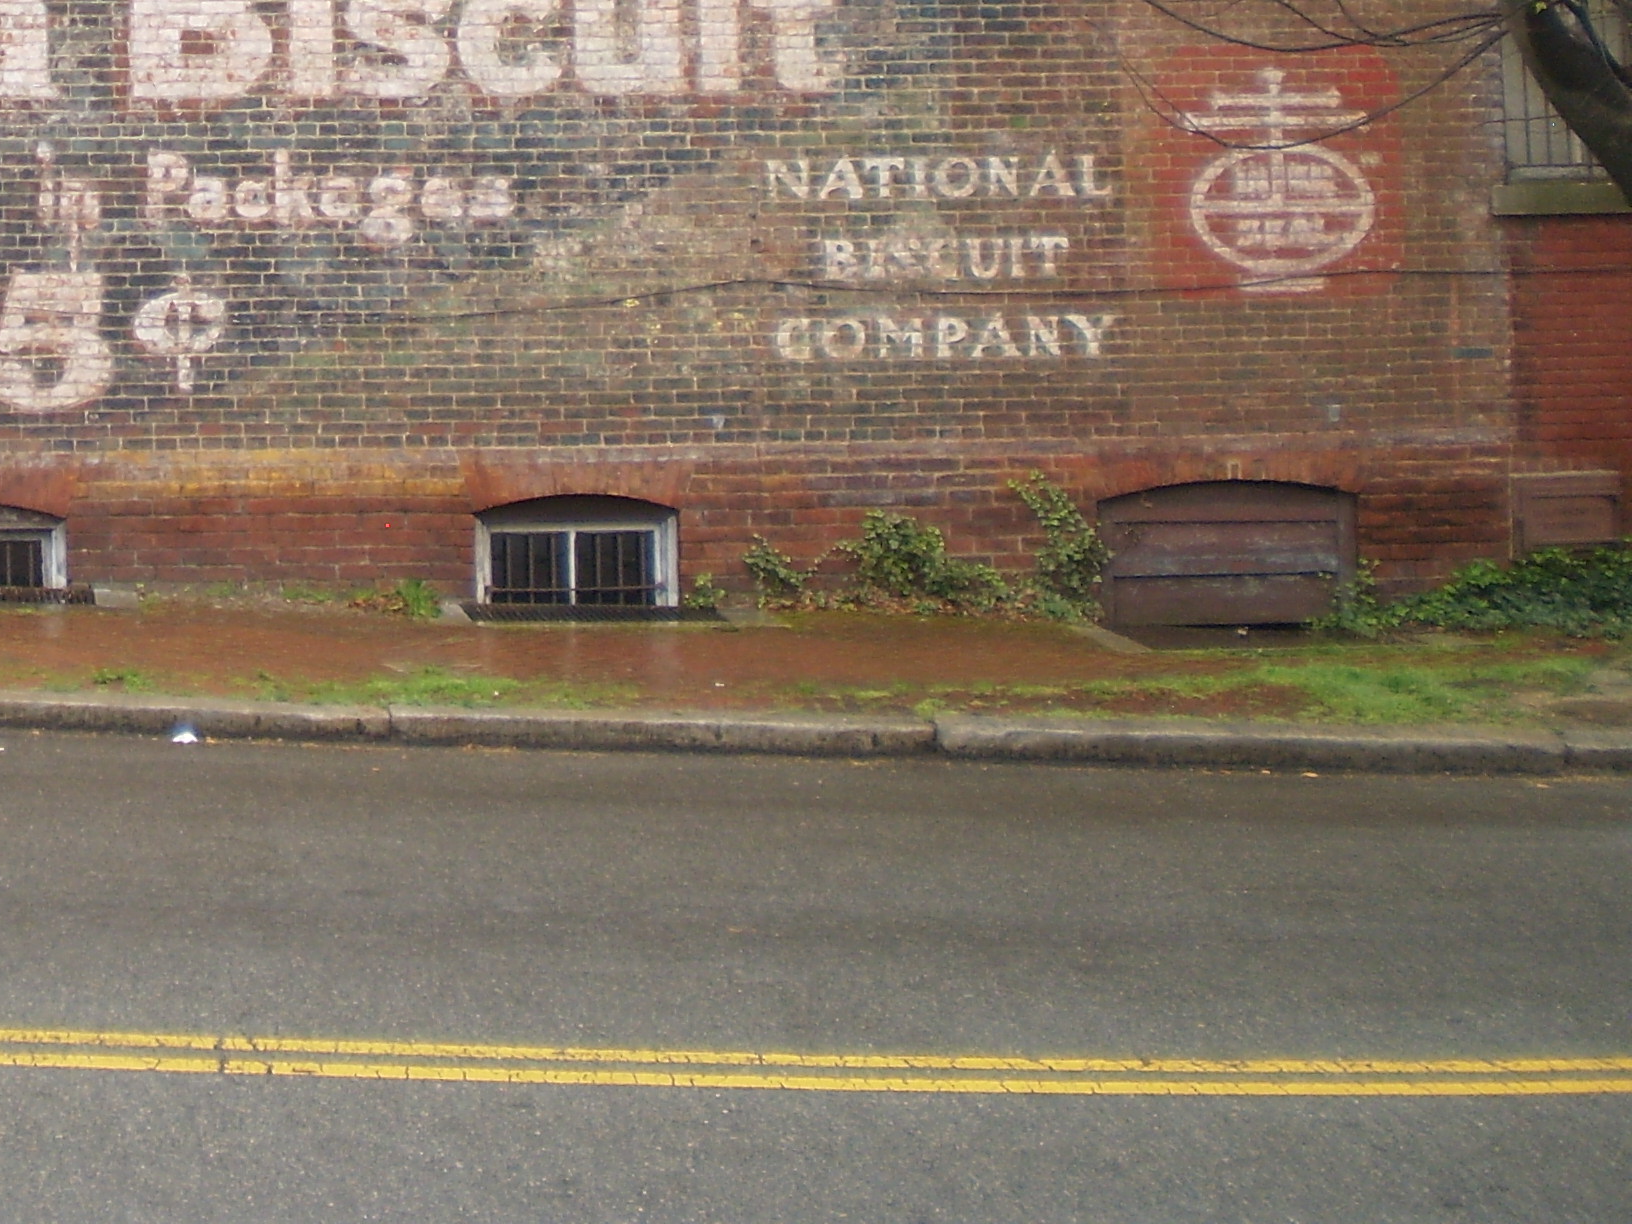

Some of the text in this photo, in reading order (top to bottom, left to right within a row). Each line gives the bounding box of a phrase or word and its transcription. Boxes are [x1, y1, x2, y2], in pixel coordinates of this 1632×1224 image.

[35, 142, 102, 230] in
[145, 148, 516, 246] Packages
[767, 152, 1114, 199] NATIONAL
[821, 234, 1069, 278] BISCUIT
[775, 311, 1117, 359] COMPANY
